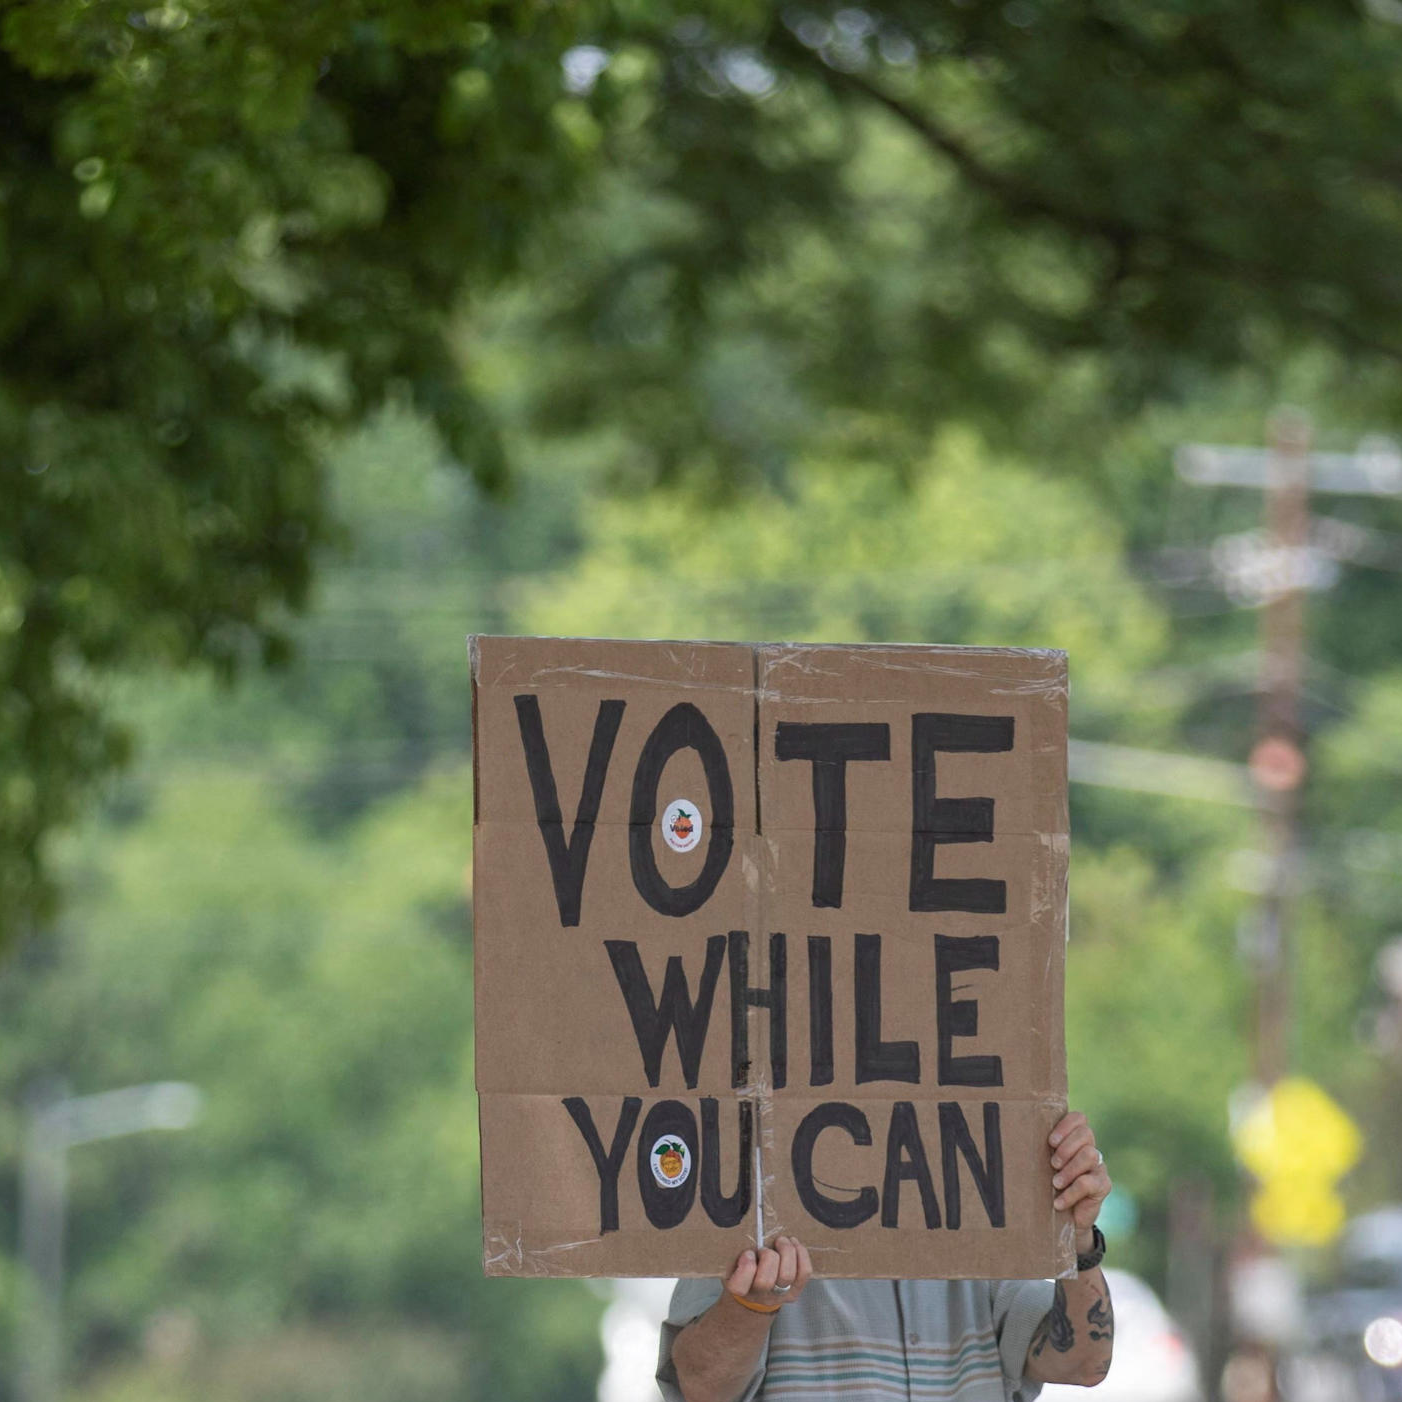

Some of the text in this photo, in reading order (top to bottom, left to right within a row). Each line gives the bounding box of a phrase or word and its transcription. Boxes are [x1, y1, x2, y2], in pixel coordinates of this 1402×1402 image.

[514, 695, 1015, 927] VOTE
[603, 930, 1004, 1089] WHILE
[561, 1095, 1006, 1235] YOU CAN
